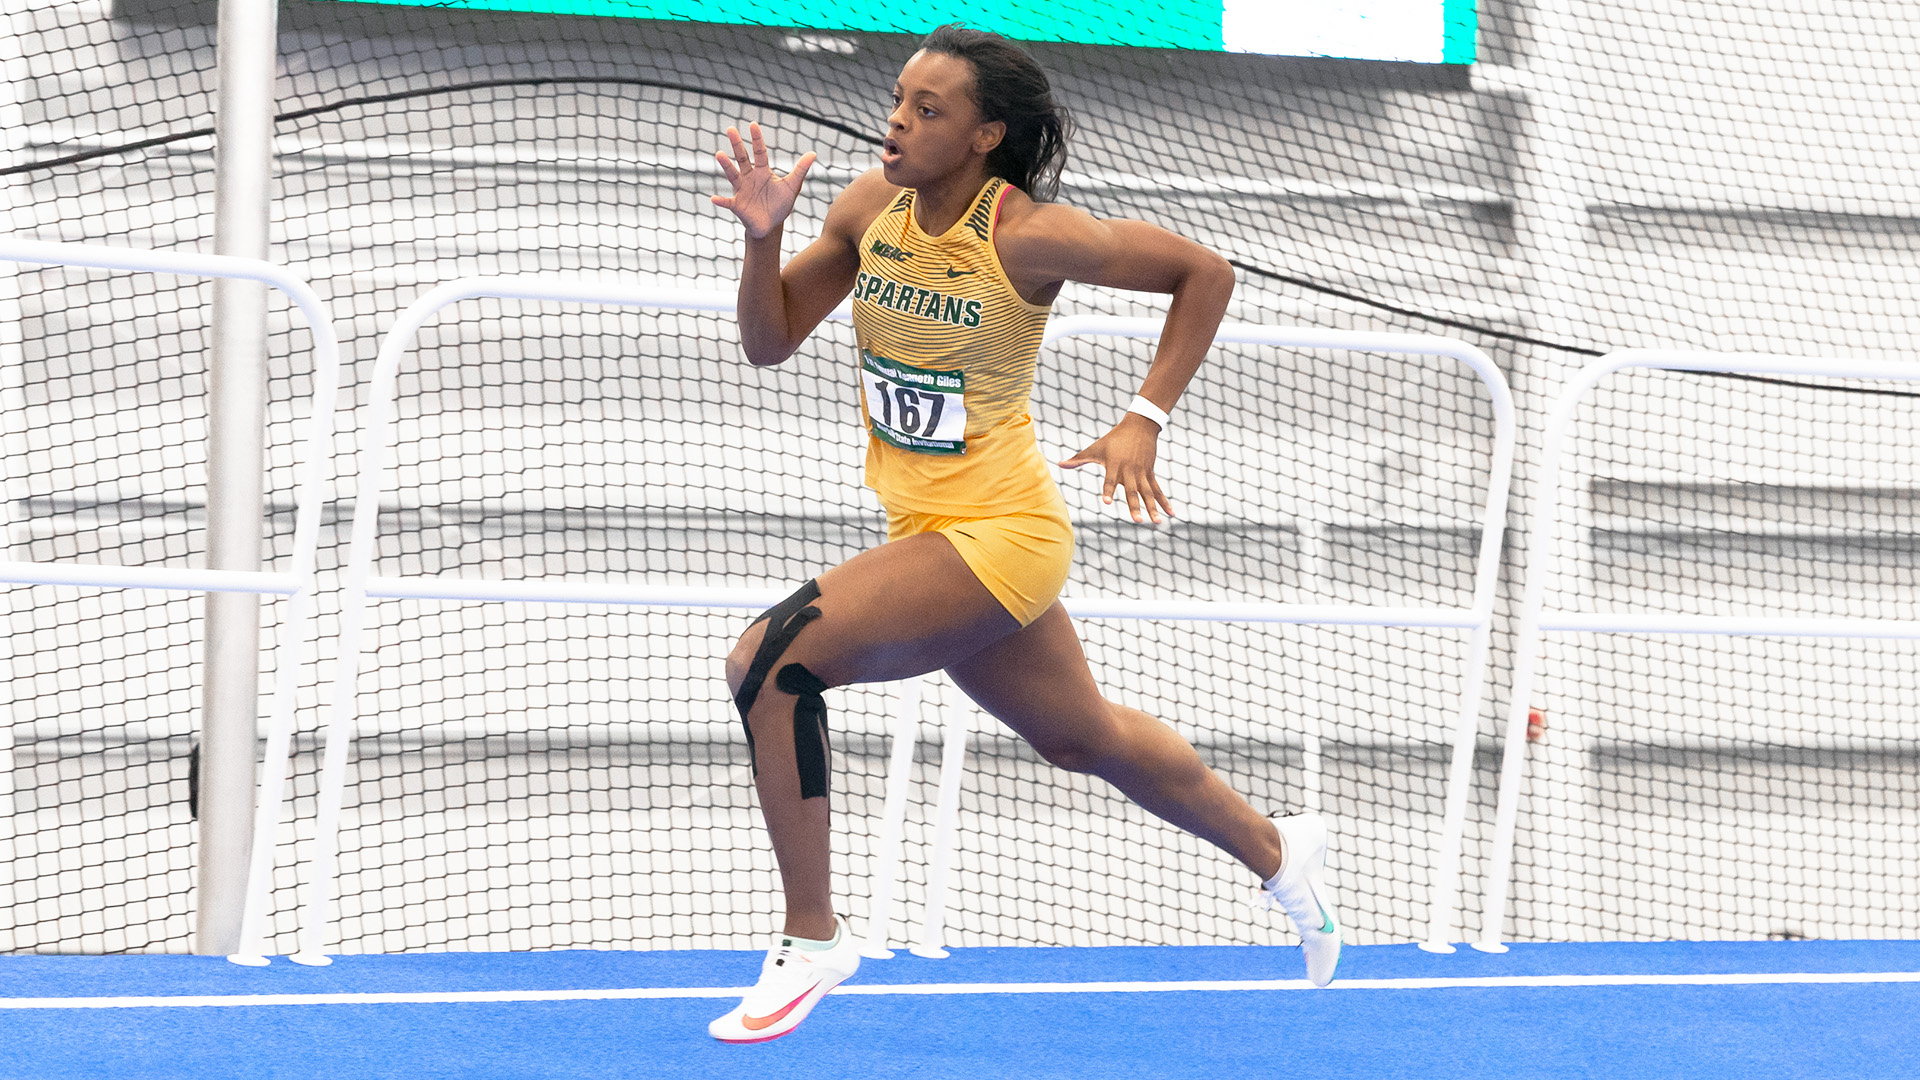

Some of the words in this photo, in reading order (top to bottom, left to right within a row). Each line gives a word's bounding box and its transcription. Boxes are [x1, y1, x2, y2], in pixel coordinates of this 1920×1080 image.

[854, 271, 983, 328] SPARTANS
[875, 380, 945, 437] 167
[936, 375, 962, 388] Giles
